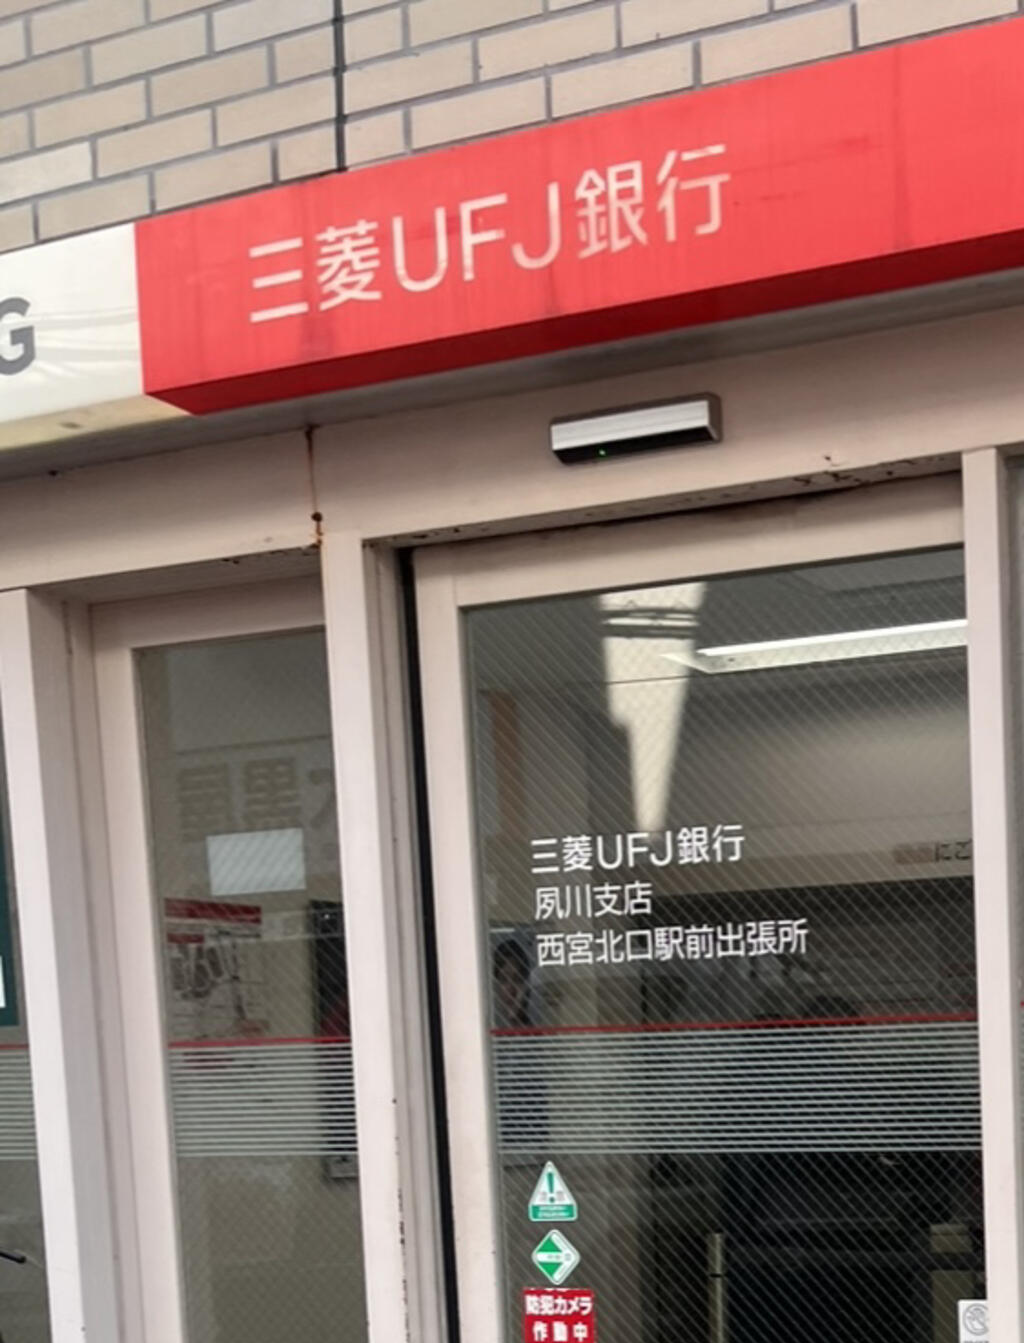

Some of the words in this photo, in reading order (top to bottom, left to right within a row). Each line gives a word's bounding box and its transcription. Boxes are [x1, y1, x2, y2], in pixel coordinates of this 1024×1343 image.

[249, 144, 731, 323] 三菱UFJ銀行
[531, 825, 744, 873] 三菱UFJ銀行
[535, 881, 652, 920] 夙川支店
[536, 918, 808, 967] 西宮北口駅前出張所
[525, 1294, 593, 1316] 防犯カメラ
